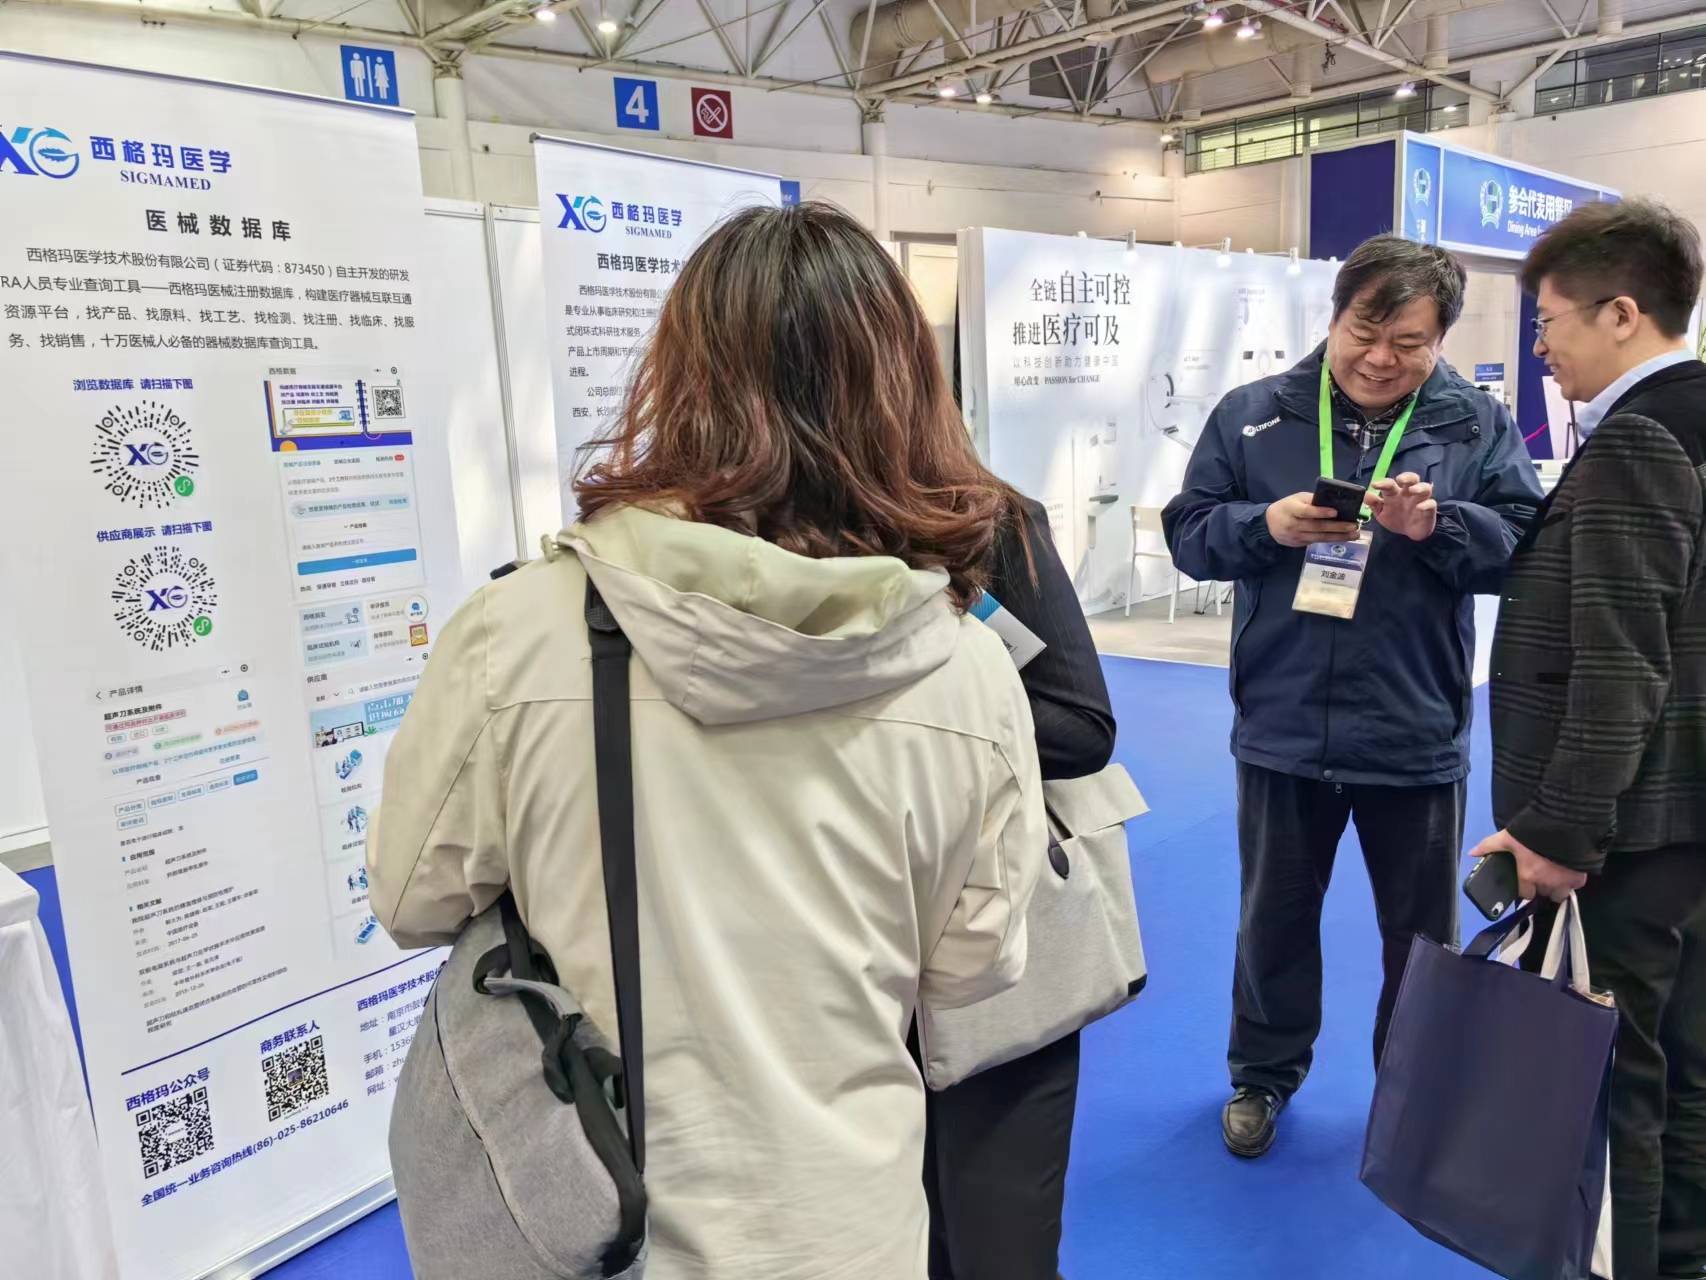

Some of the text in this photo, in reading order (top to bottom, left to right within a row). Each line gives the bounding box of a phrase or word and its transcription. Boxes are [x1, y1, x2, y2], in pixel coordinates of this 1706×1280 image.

[625, 85, 649, 124] 4
[89, 136, 232, 174] 西格玛医学
[120, 169, 211, 192] SIGMAMED
[145, 209, 292, 241] 医械数据库
[611, 201, 682, 227] 西格玛医学
[625, 226, 672, 239] SIGMAMED
[1031, 270, 1131, 306] 全链自主可控
[1013, 312, 1120, 346] 推进医疗可及
[73, 378, 194, 391] 浏览数据库 请扫描下图
[96, 521, 213, 543] 供应商展示 请扫描下图
[260, 1019, 320, 1054] 商务联系人
[126, 1067, 210, 1111] 西格玛公众号
